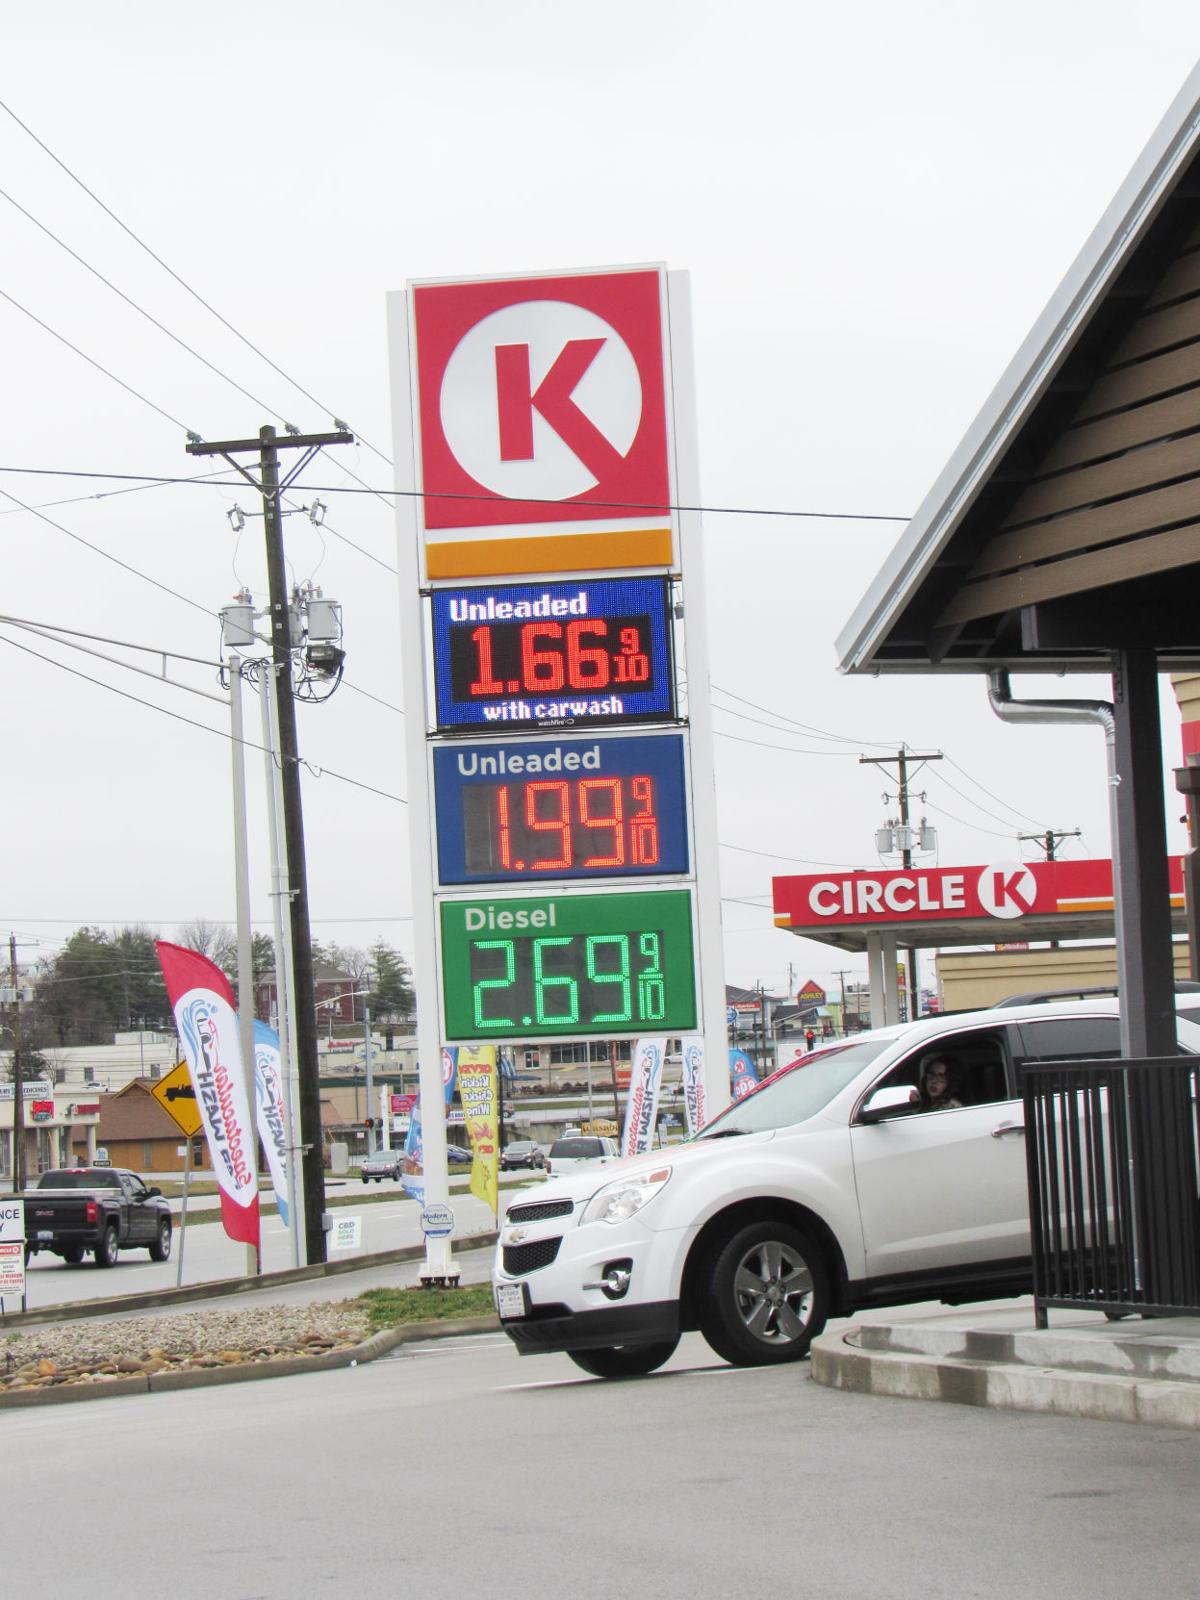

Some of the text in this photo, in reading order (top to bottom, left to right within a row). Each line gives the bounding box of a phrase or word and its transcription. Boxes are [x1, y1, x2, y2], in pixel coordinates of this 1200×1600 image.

[495, 337, 626, 487] K
[450, 592, 588, 622] Unleaded
[470, 617, 649, 695] 1.66 9 10
[482, 696, 624, 721] with carwash
[457, 745, 601, 776] Unleaded
[498, 775, 659, 871] 1.99 9 10
[808, 871, 1033, 917] CIRCLE K
[464, 903, 556, 931] Diesel
[473, 932, 665, 1028] 2.69 9 10
[800, 992, 824, 1000] ASHLEY
[638, 1090, 654, 1136] WASH
[338, 1221, 355, 1230] CBD
